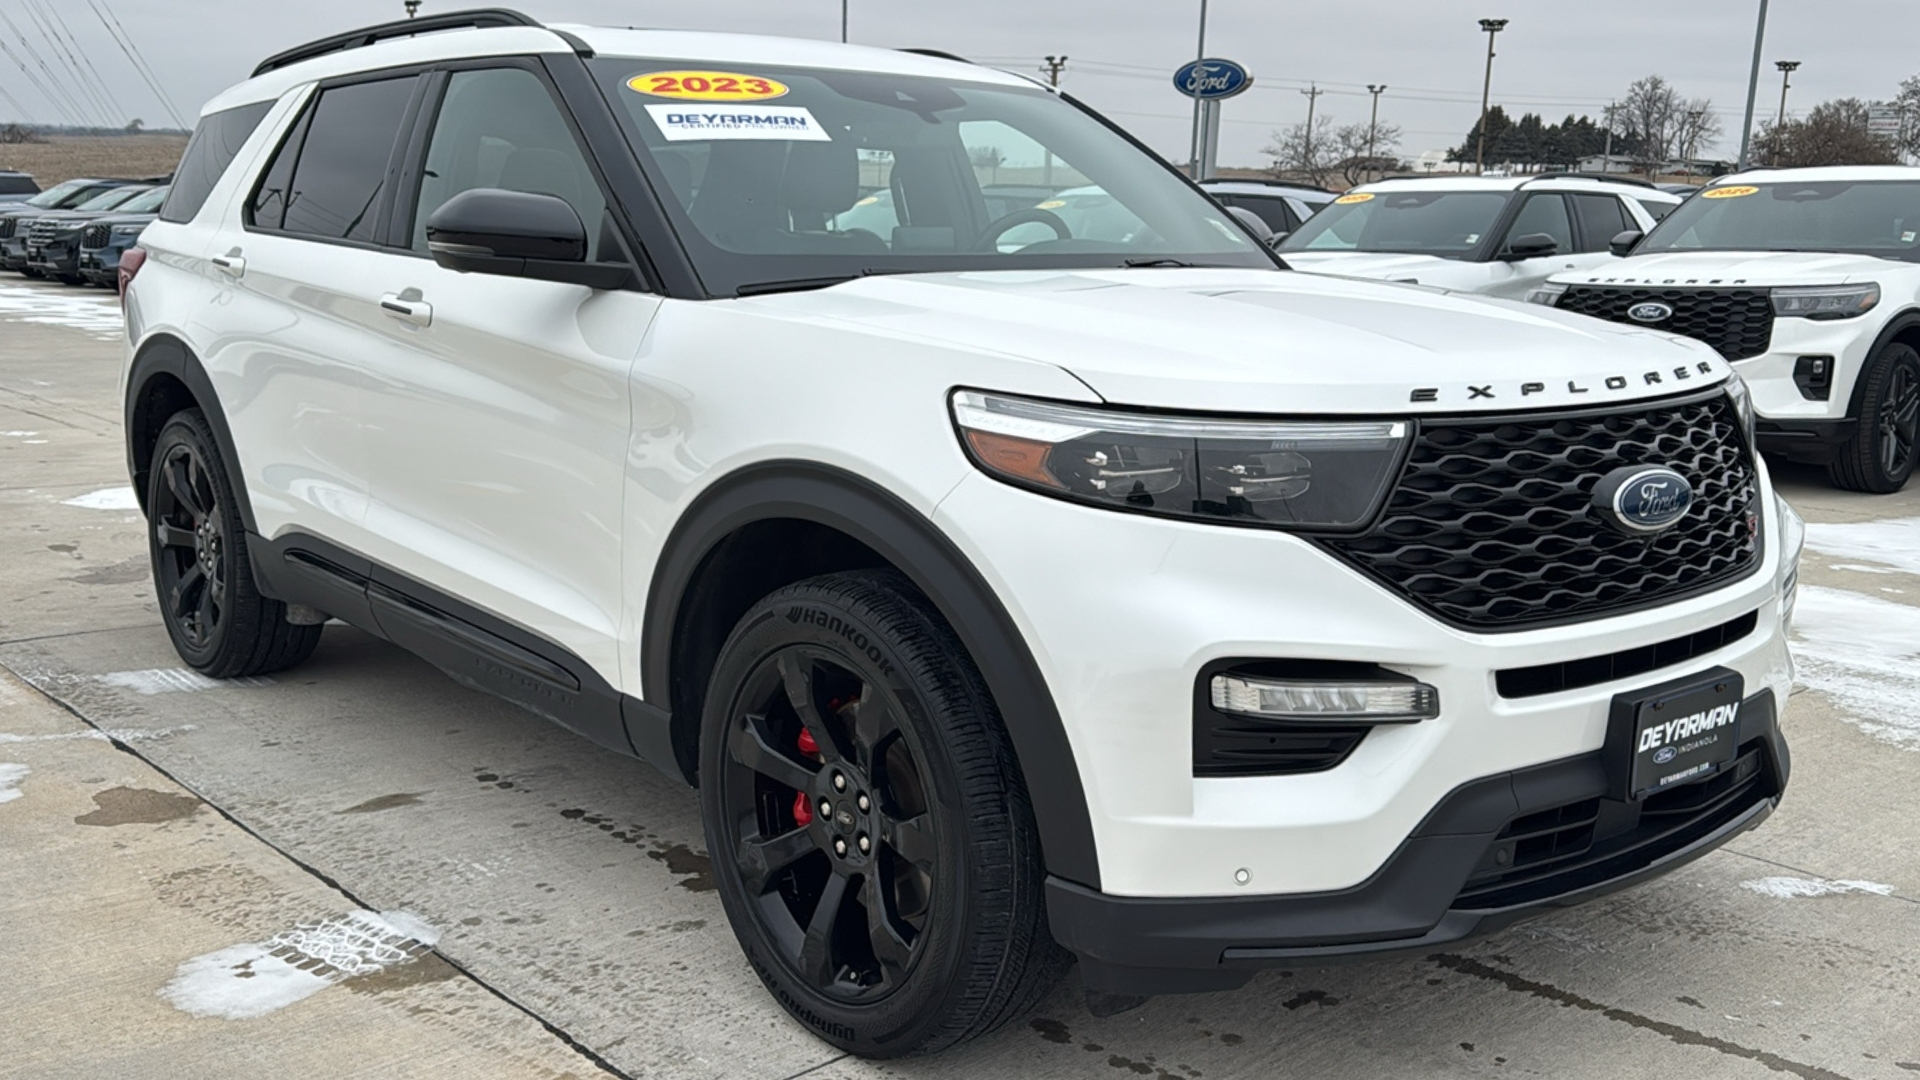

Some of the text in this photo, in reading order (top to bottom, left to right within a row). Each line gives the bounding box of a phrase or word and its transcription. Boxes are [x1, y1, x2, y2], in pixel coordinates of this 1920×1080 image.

[650, 76, 774, 95] 2023
[1186, 66, 1231, 91] Ford
[666, 113, 807, 126] DEYARMAN
[1635, 306, 1661, 318] Ford
[1409, 361, 1713, 403] EXPLORER
[1638, 482, 1681, 517] Ford
[1638, 702, 1740, 754] DEYARMAN
[1677, 734, 1719, 755] INDIANOLA
